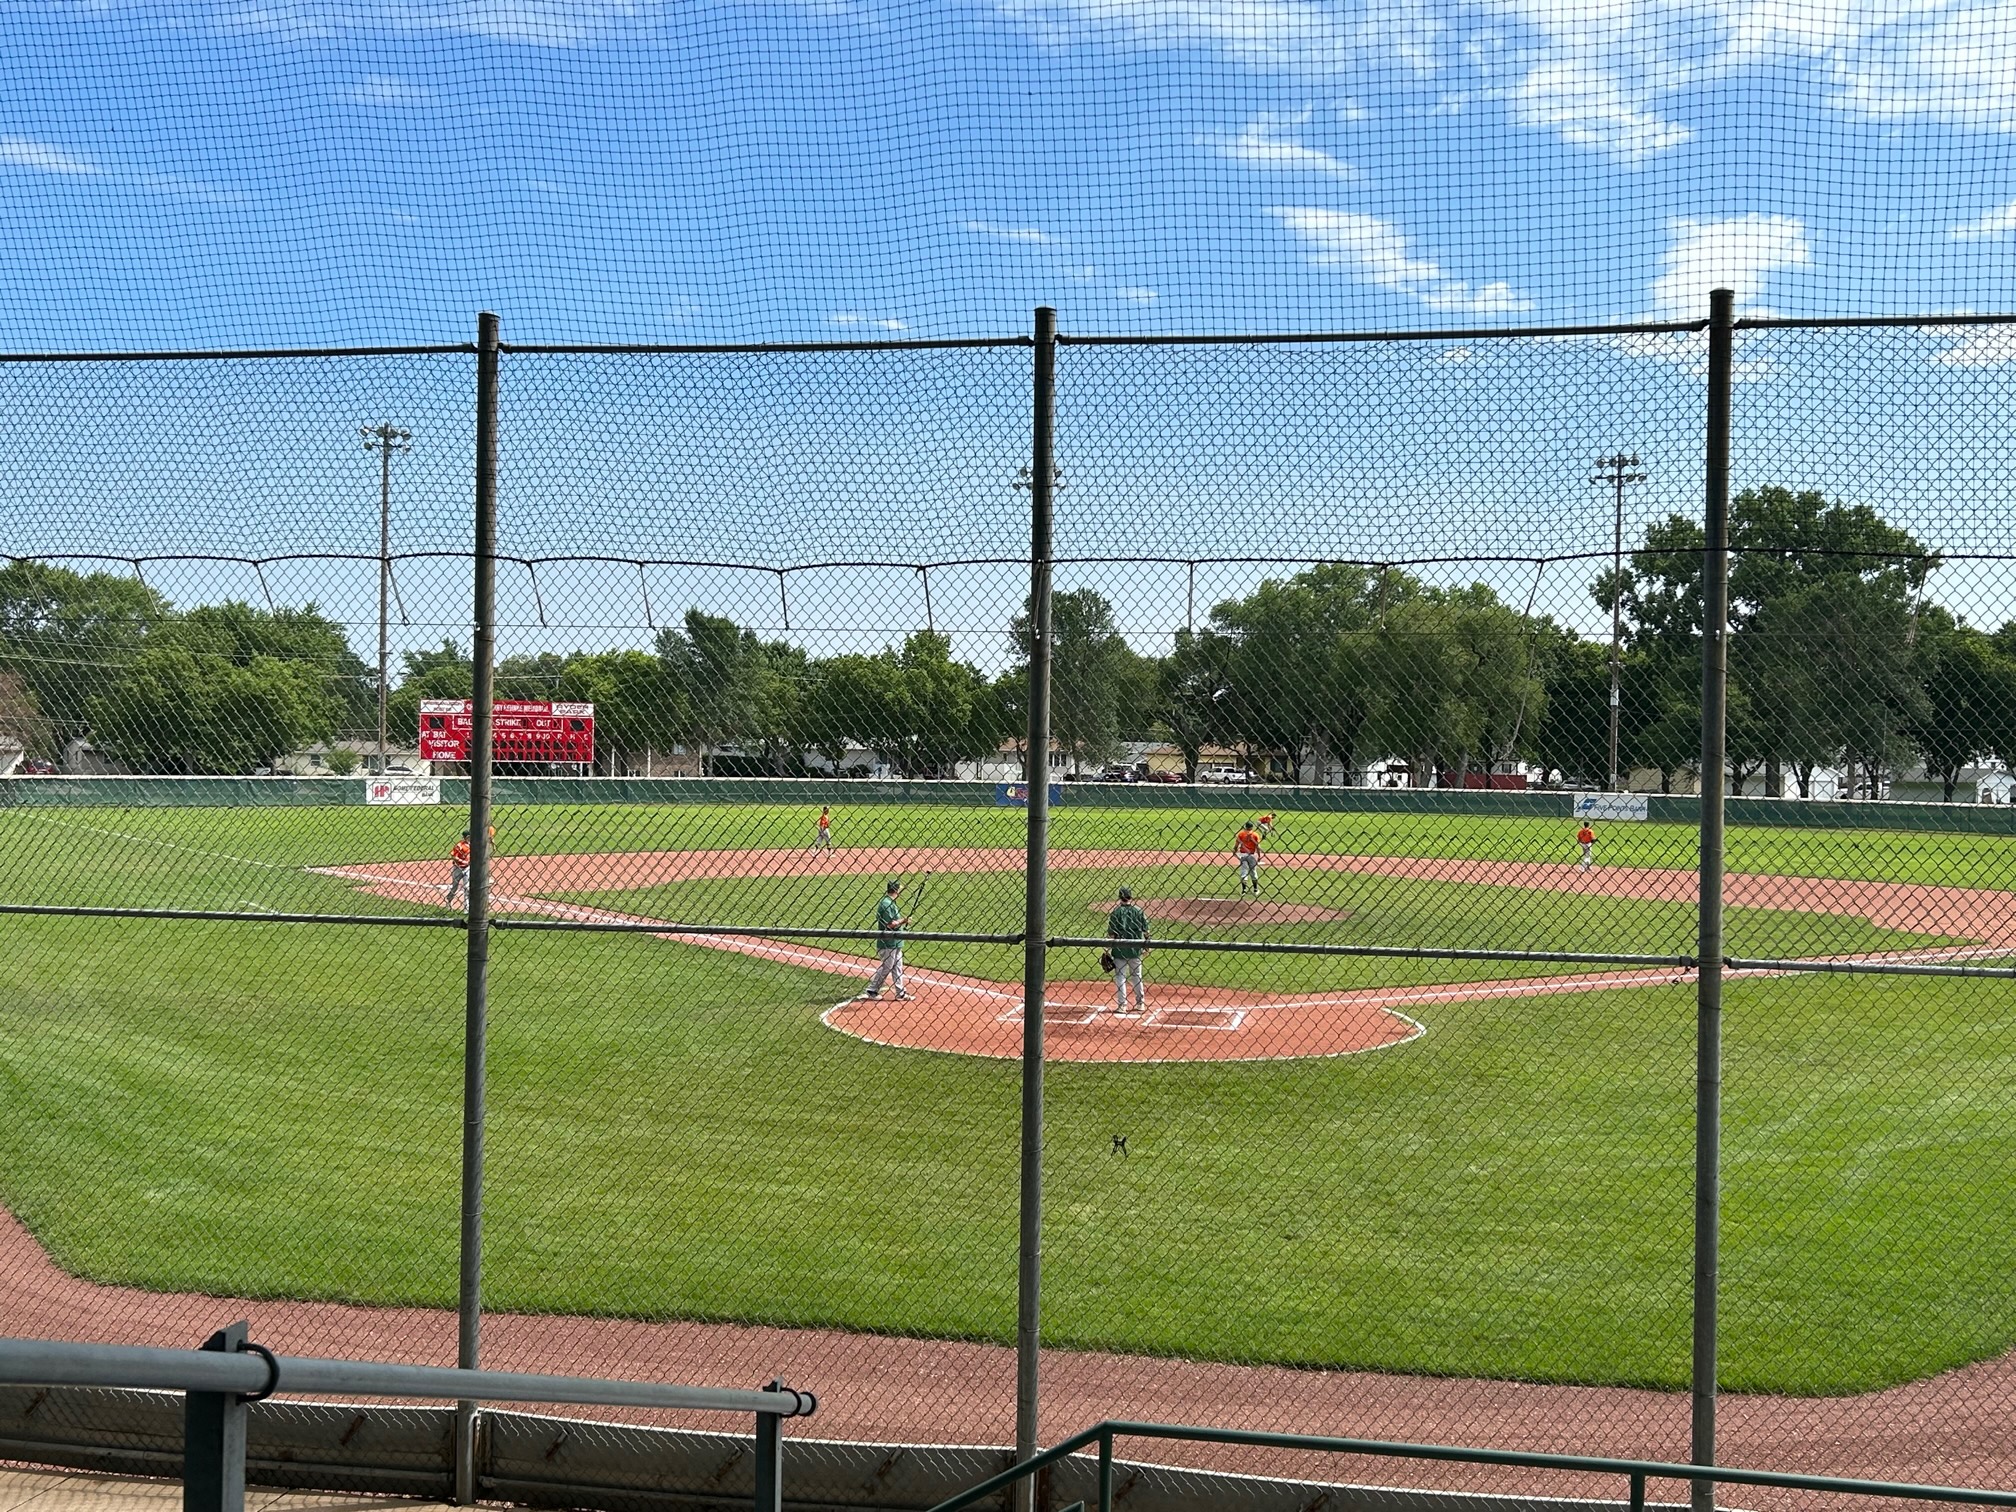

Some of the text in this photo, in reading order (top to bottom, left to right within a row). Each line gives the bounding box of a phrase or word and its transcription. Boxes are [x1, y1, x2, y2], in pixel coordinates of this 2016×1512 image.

[457, 718, 473, 726] BAL
[495, 718, 521, 727] STRIKE
[536, 719, 551, 727] OUT
[421, 730, 446, 739] AT BAT
[428, 740, 460, 748] VISITOR
[432, 751, 457, 759] HOME
